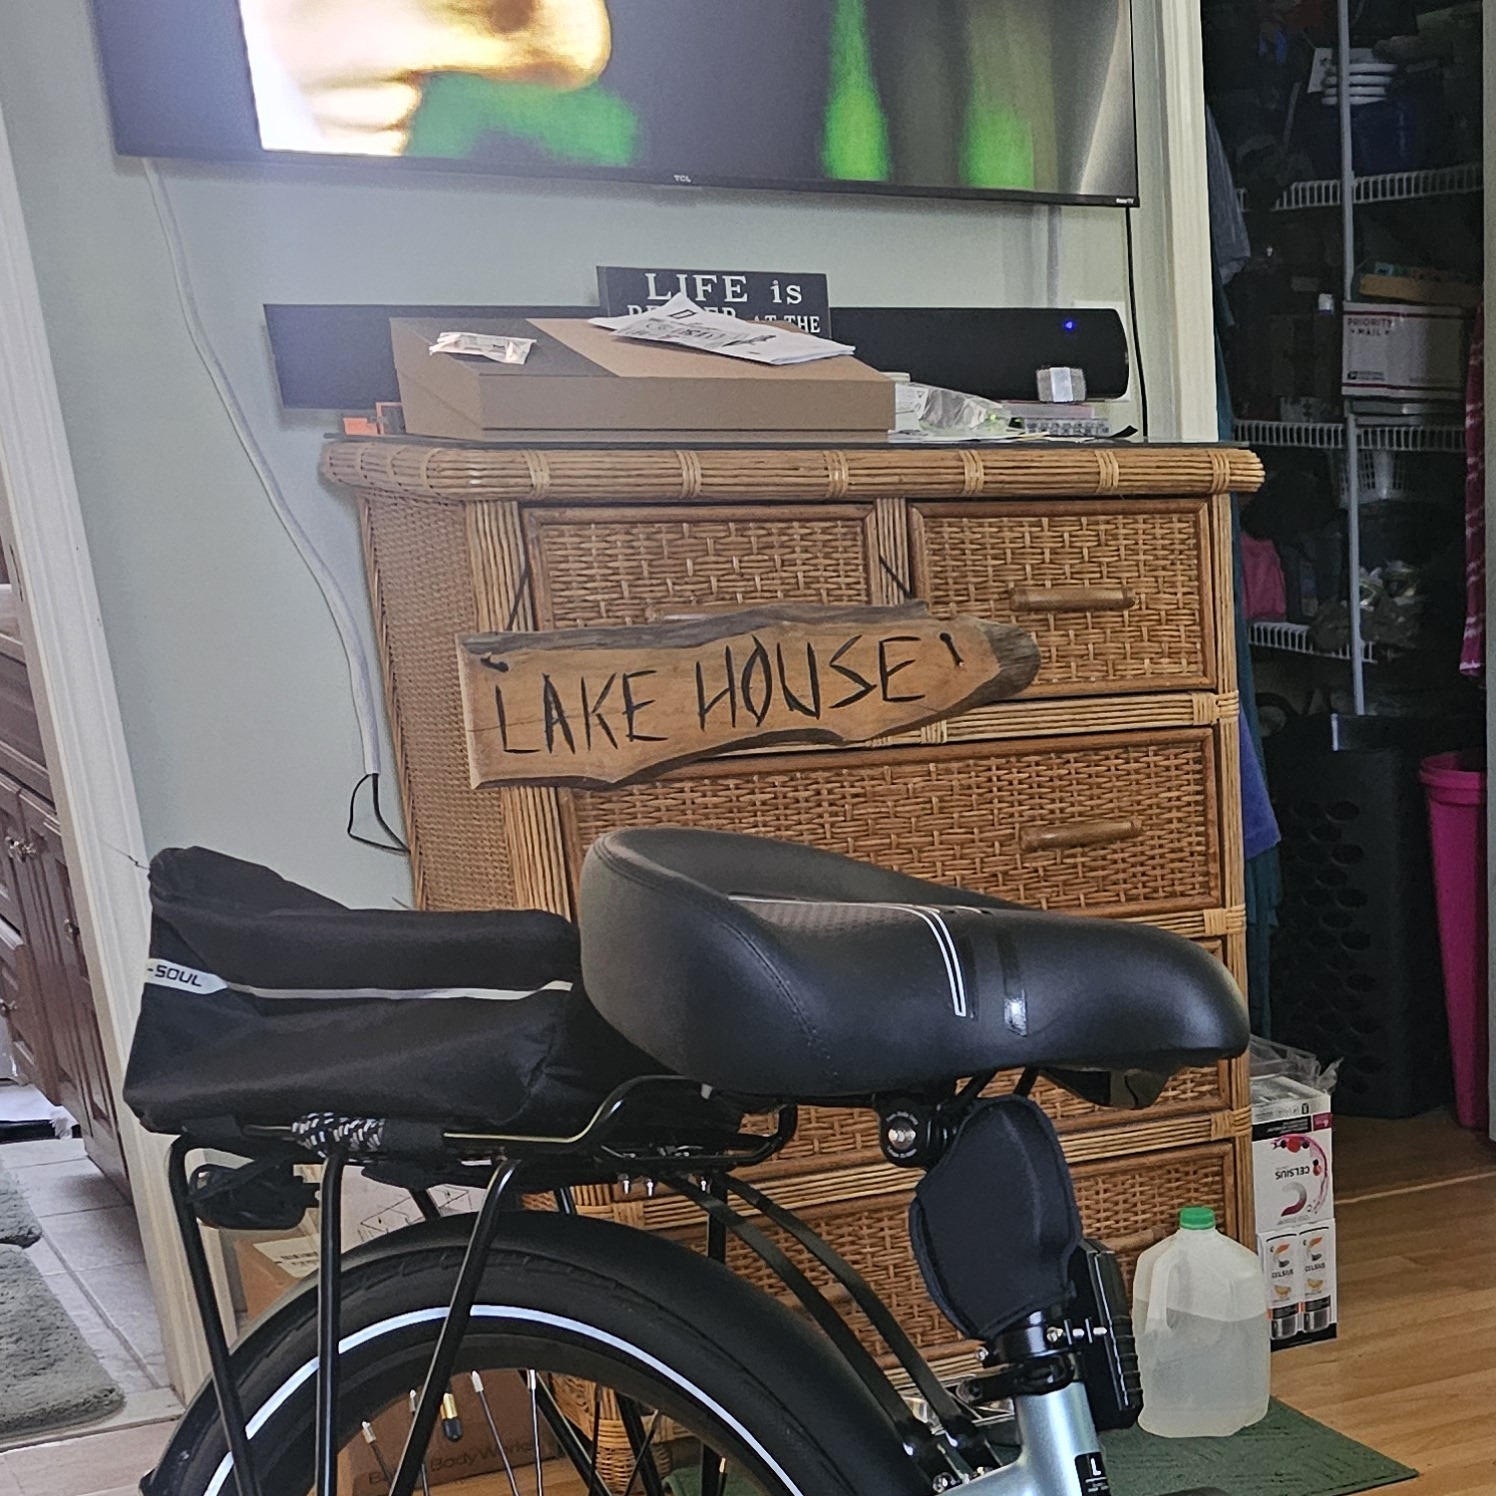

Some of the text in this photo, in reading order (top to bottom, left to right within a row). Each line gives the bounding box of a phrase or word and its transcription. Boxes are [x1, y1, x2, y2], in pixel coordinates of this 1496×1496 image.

[673, 174, 692, 183] TCL
[644, 273, 802, 304] LIFE is
[495, 633, 926, 755] LAKE HOUSE
[1274, 1165, 1311, 1181] CELSIUS
